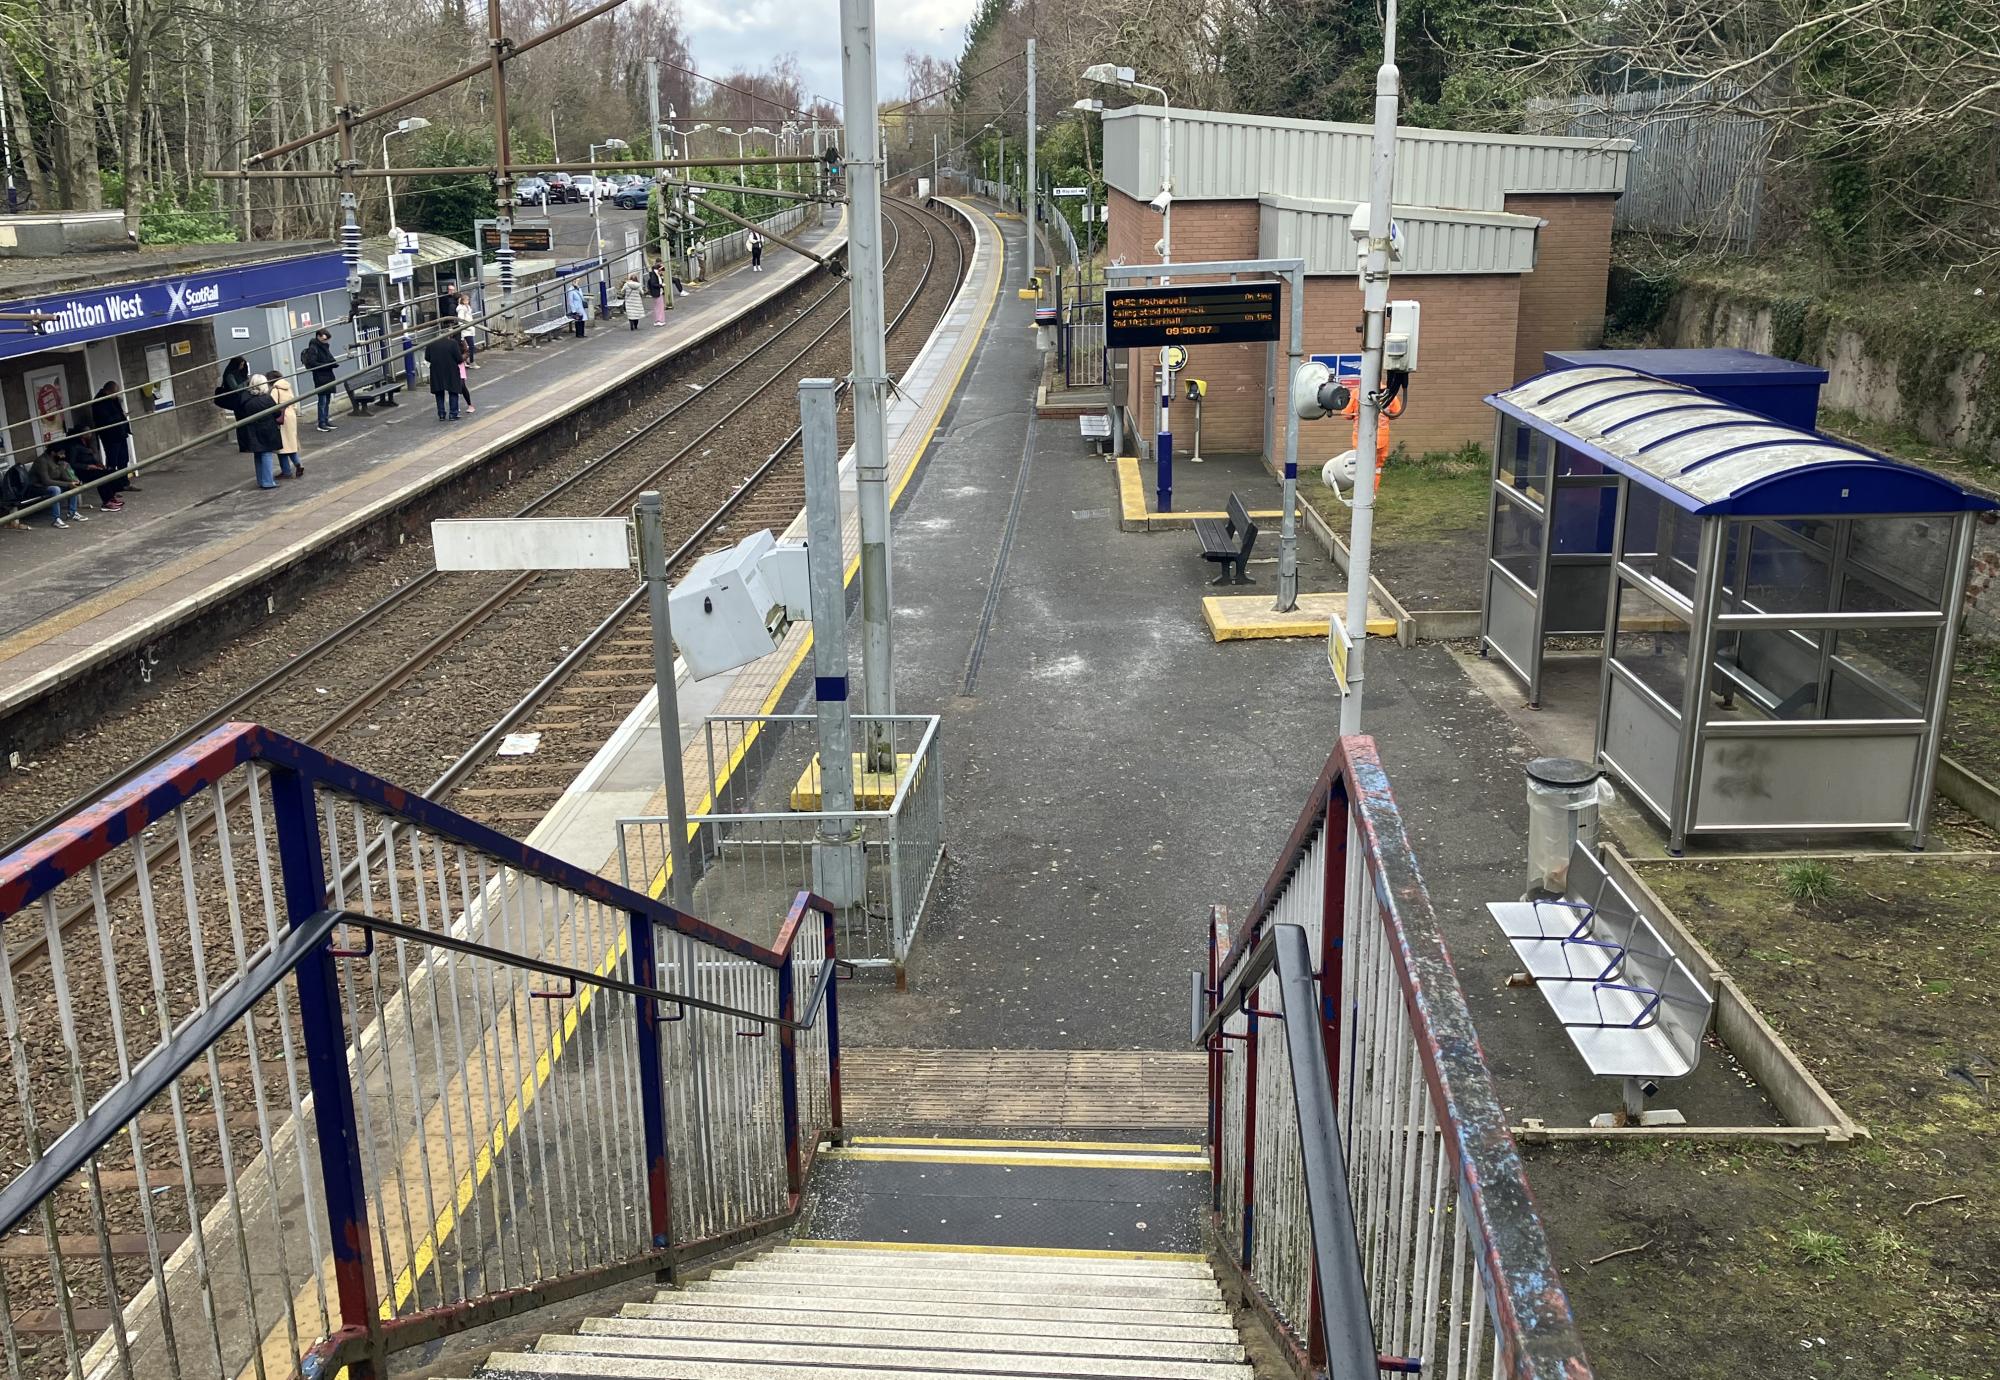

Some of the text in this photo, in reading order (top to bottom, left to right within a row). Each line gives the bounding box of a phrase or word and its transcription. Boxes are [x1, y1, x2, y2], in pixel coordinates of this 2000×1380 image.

[403, 235, 412, 248] 1
[185, 284, 219, 305] ScotRail
[106, 293, 144, 322] West
[1166, 326, 1212, 335] 09:50:07
